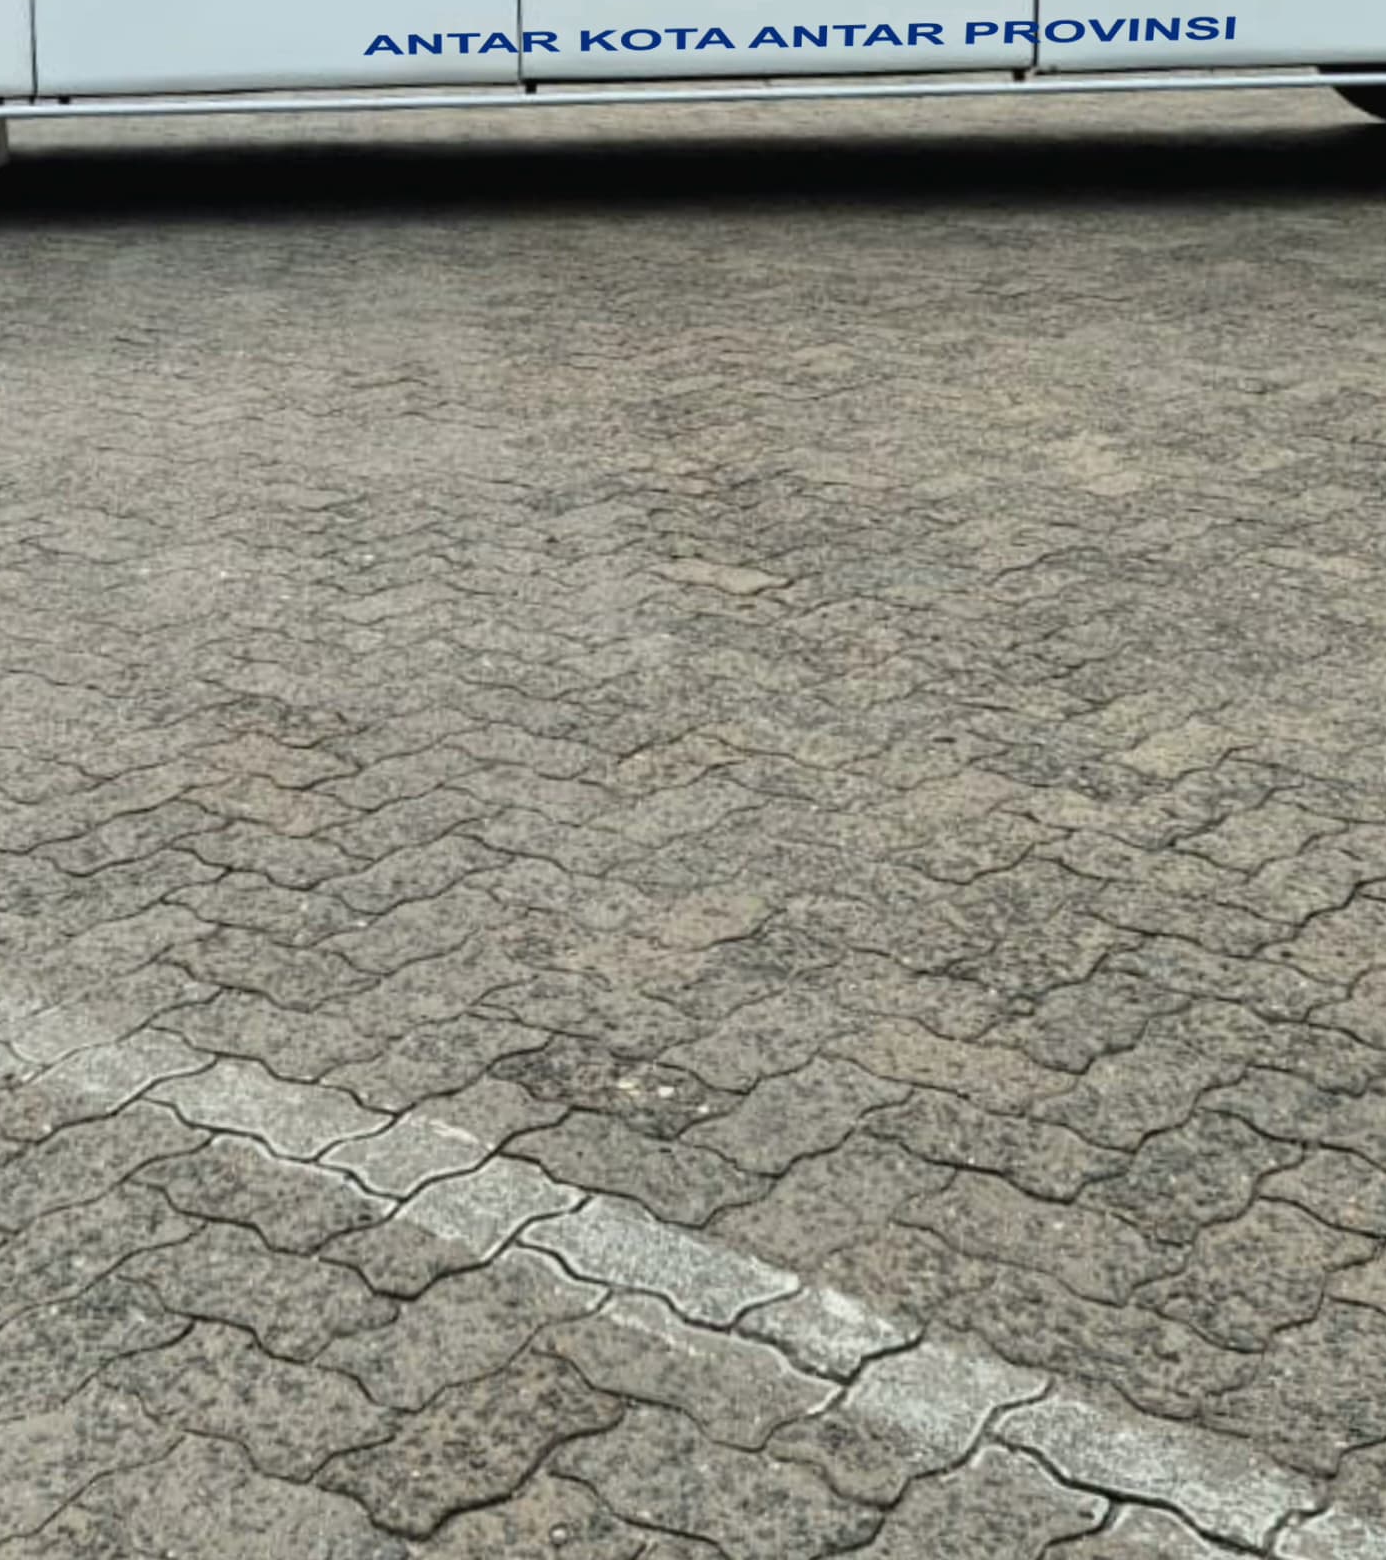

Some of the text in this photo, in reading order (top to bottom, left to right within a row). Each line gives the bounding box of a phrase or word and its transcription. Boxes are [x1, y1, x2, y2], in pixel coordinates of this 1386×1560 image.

[363, 16, 1237, 56] ANTAR KOTA ANTAR PROVINSI
